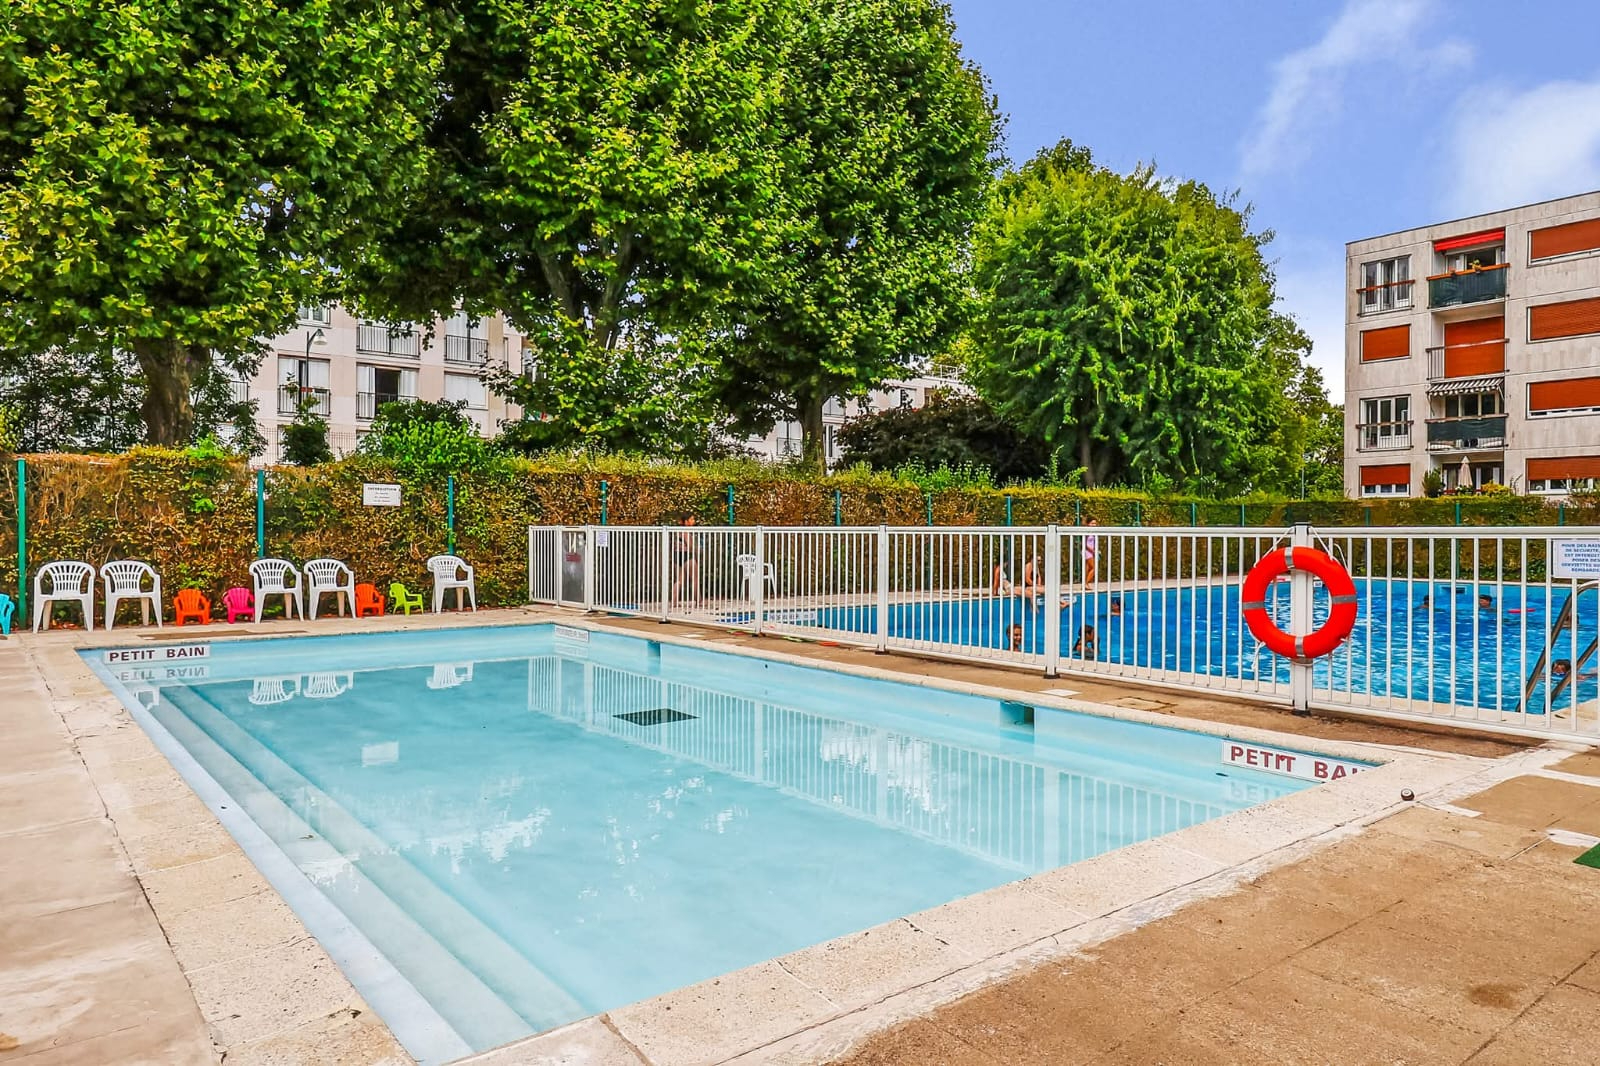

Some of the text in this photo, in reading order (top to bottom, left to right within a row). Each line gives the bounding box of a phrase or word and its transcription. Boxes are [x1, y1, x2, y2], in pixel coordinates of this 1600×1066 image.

[109, 646, 205, 662] PETIT BAIN
[1230, 745, 1366, 781] PETIT BA
